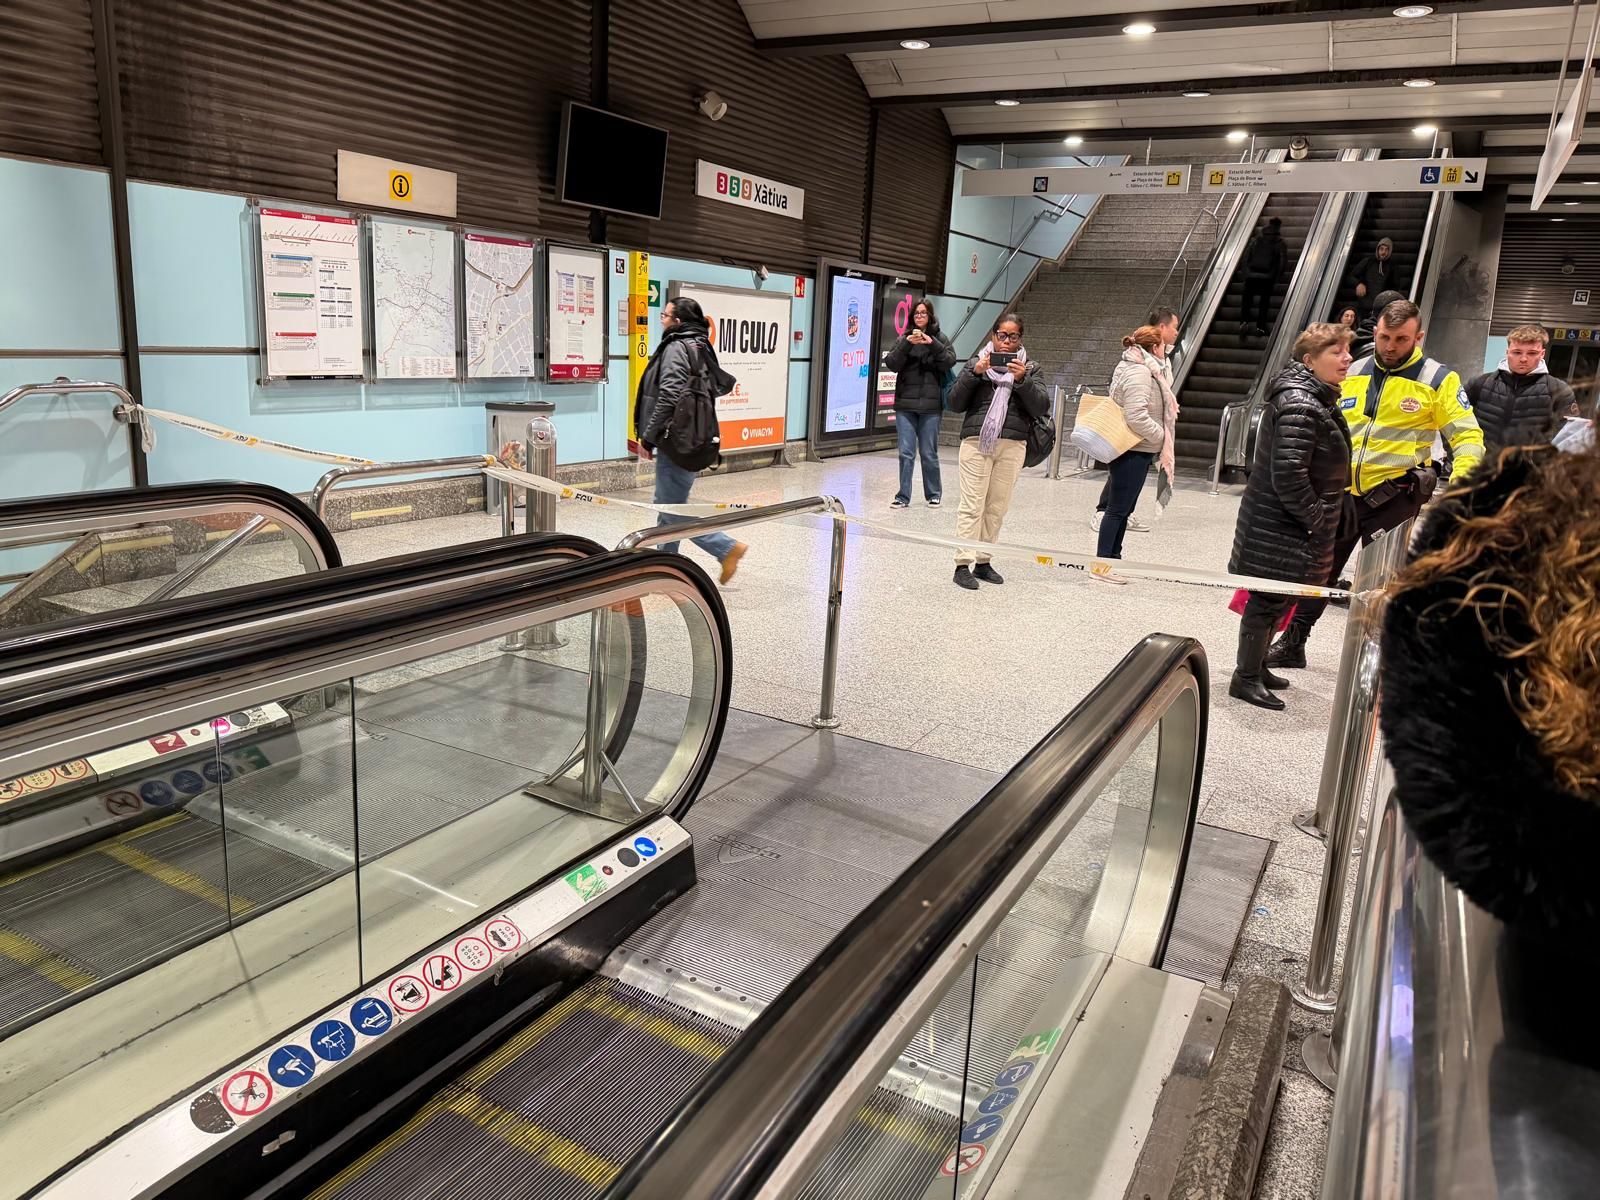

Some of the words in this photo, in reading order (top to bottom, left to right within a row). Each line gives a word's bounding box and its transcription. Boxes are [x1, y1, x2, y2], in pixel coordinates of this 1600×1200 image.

[719, 176, 726, 191] 3
[732, 179, 738, 194] 5
[744, 182, 750, 197] 9
[754, 183, 788, 210] Xàtiva
[719, 318, 737, 354] MI
[740, 320, 778, 354] CULO
[843, 352, 854, 368] FLY
[856, 349, 865, 365] TO
[750, 427, 774, 438] VIVAGYM
[504, 926, 515, 937] NO
[473, 946, 484, 956] NO
